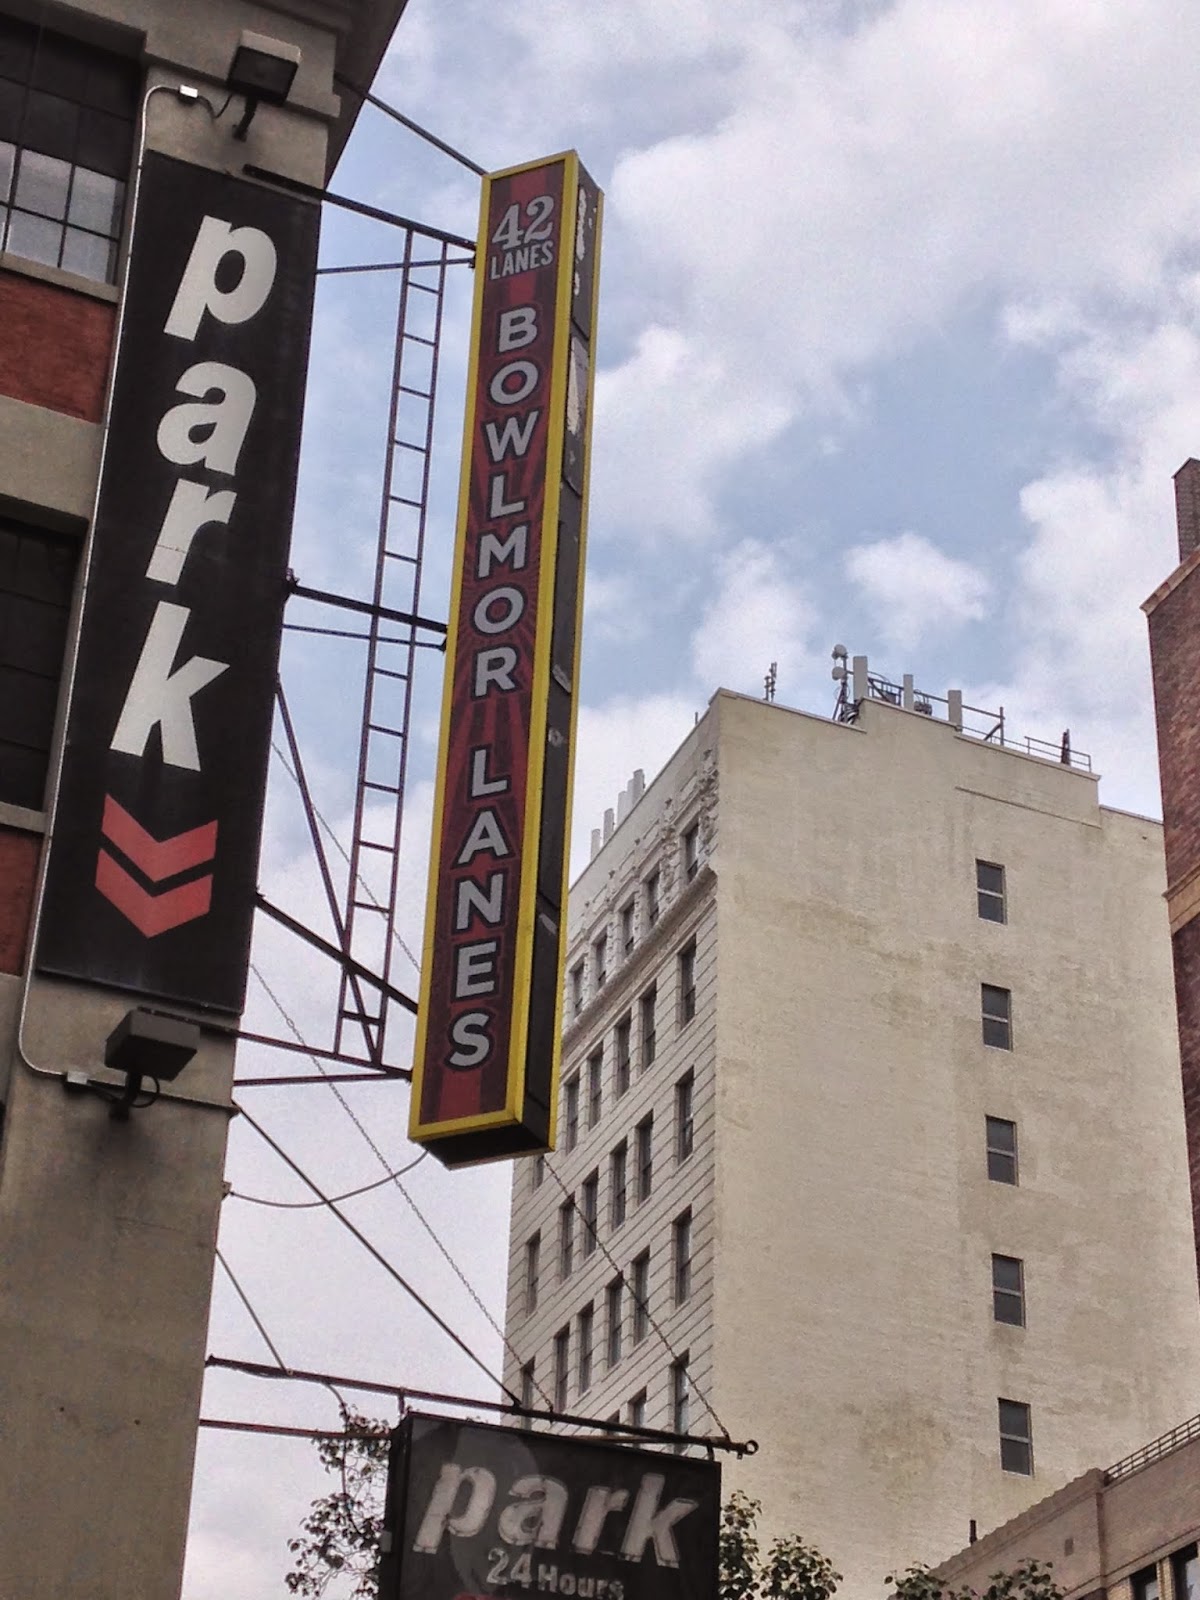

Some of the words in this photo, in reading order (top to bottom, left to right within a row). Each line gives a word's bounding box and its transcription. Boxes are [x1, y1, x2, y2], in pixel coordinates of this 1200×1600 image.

[491, 241, 554, 280] LANES
[492, 195, 555, 250] 42
[109, 214, 277, 772] park
[472, 306, 539, 697] BOWLMOR
[448, 748, 511, 1068] LANES
[412, 1462, 699, 1569] park
[486, 1547, 533, 1589] 24
